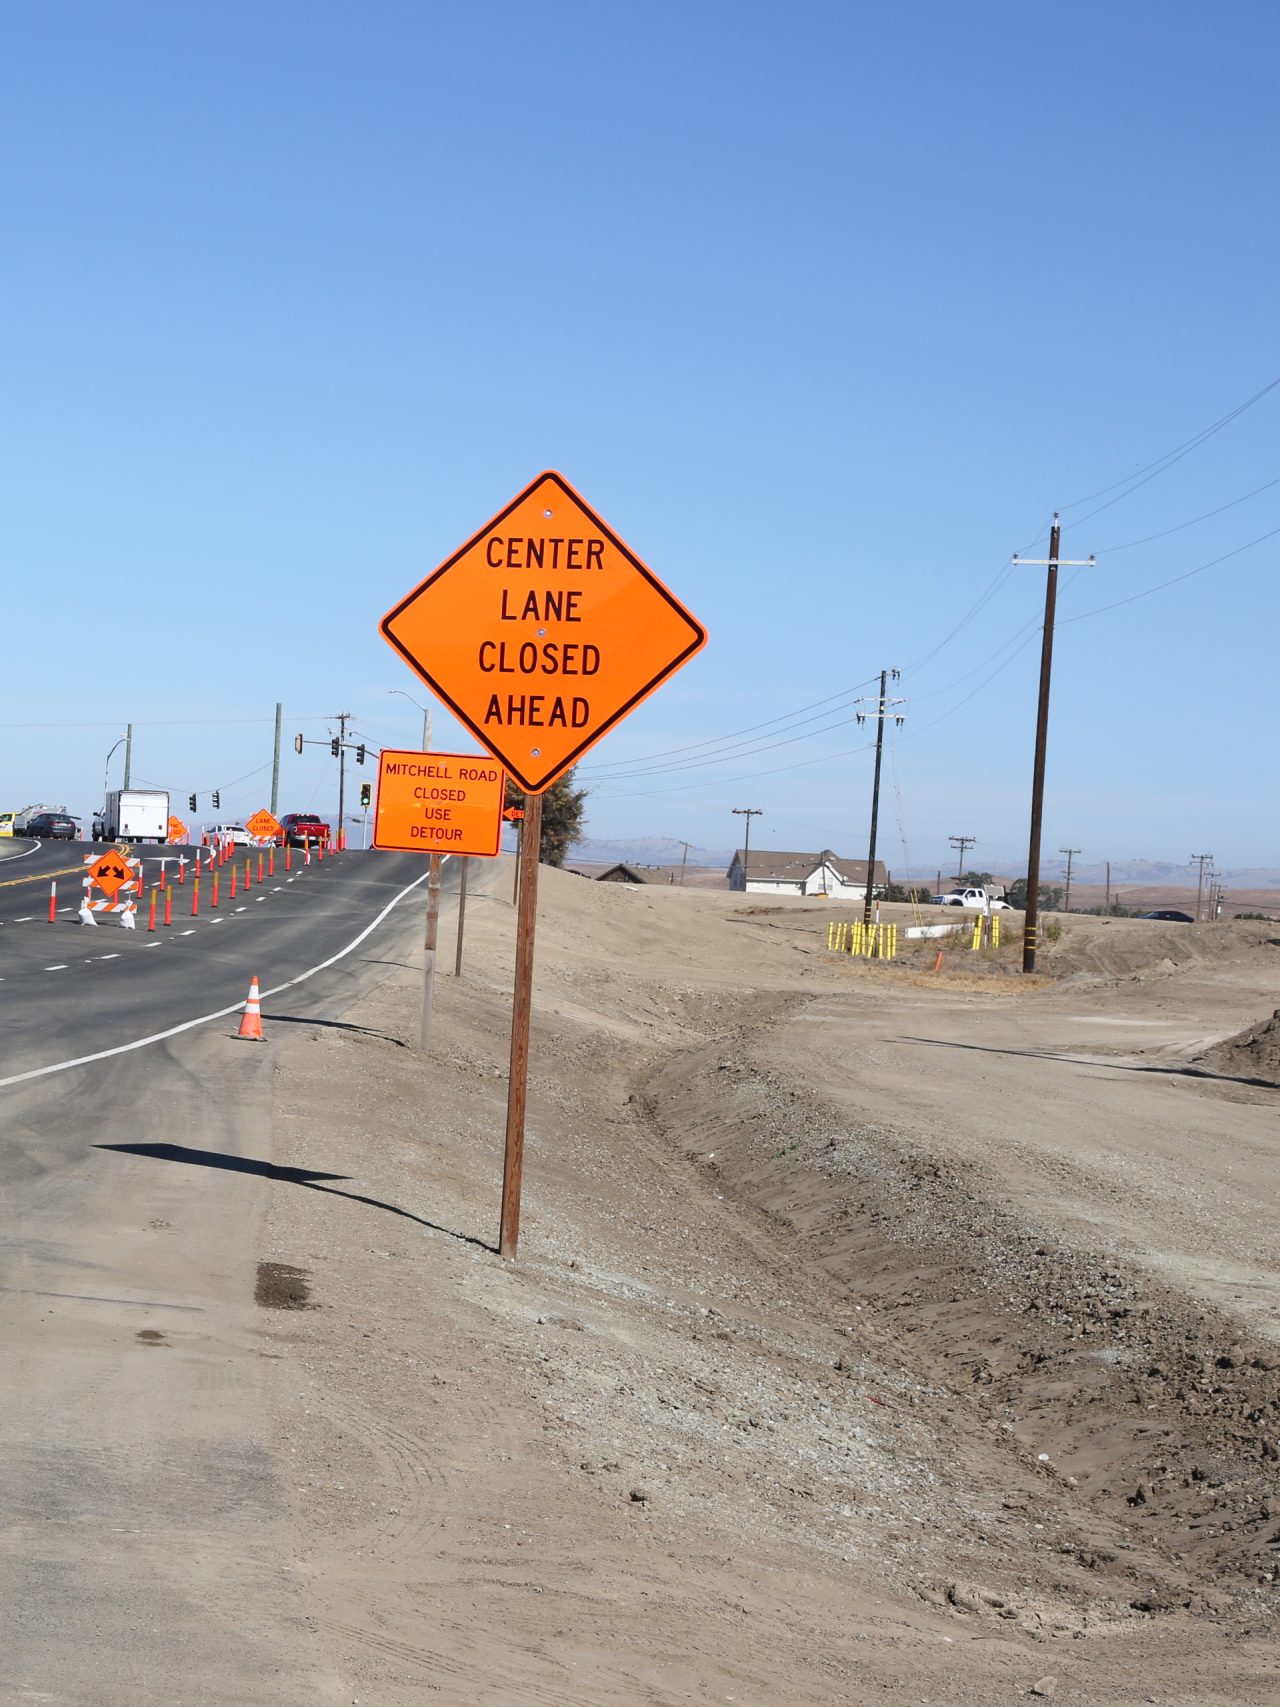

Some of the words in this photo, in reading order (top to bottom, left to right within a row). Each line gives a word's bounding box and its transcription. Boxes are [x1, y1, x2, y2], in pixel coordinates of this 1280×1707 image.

[486, 536, 605, 570] CENTER
[501, 589, 583, 622] LANE
[478, 640, 601, 676] CLOSED
[484, 693, 590, 728] AHEAD
[385, 763, 452, 779] MITCHELL
[459, 768, 498, 782] ROAD
[413, 786, 466, 802] CLOSED
[425, 807, 452, 821] USE
[410, 825, 463, 841] DETOUR
